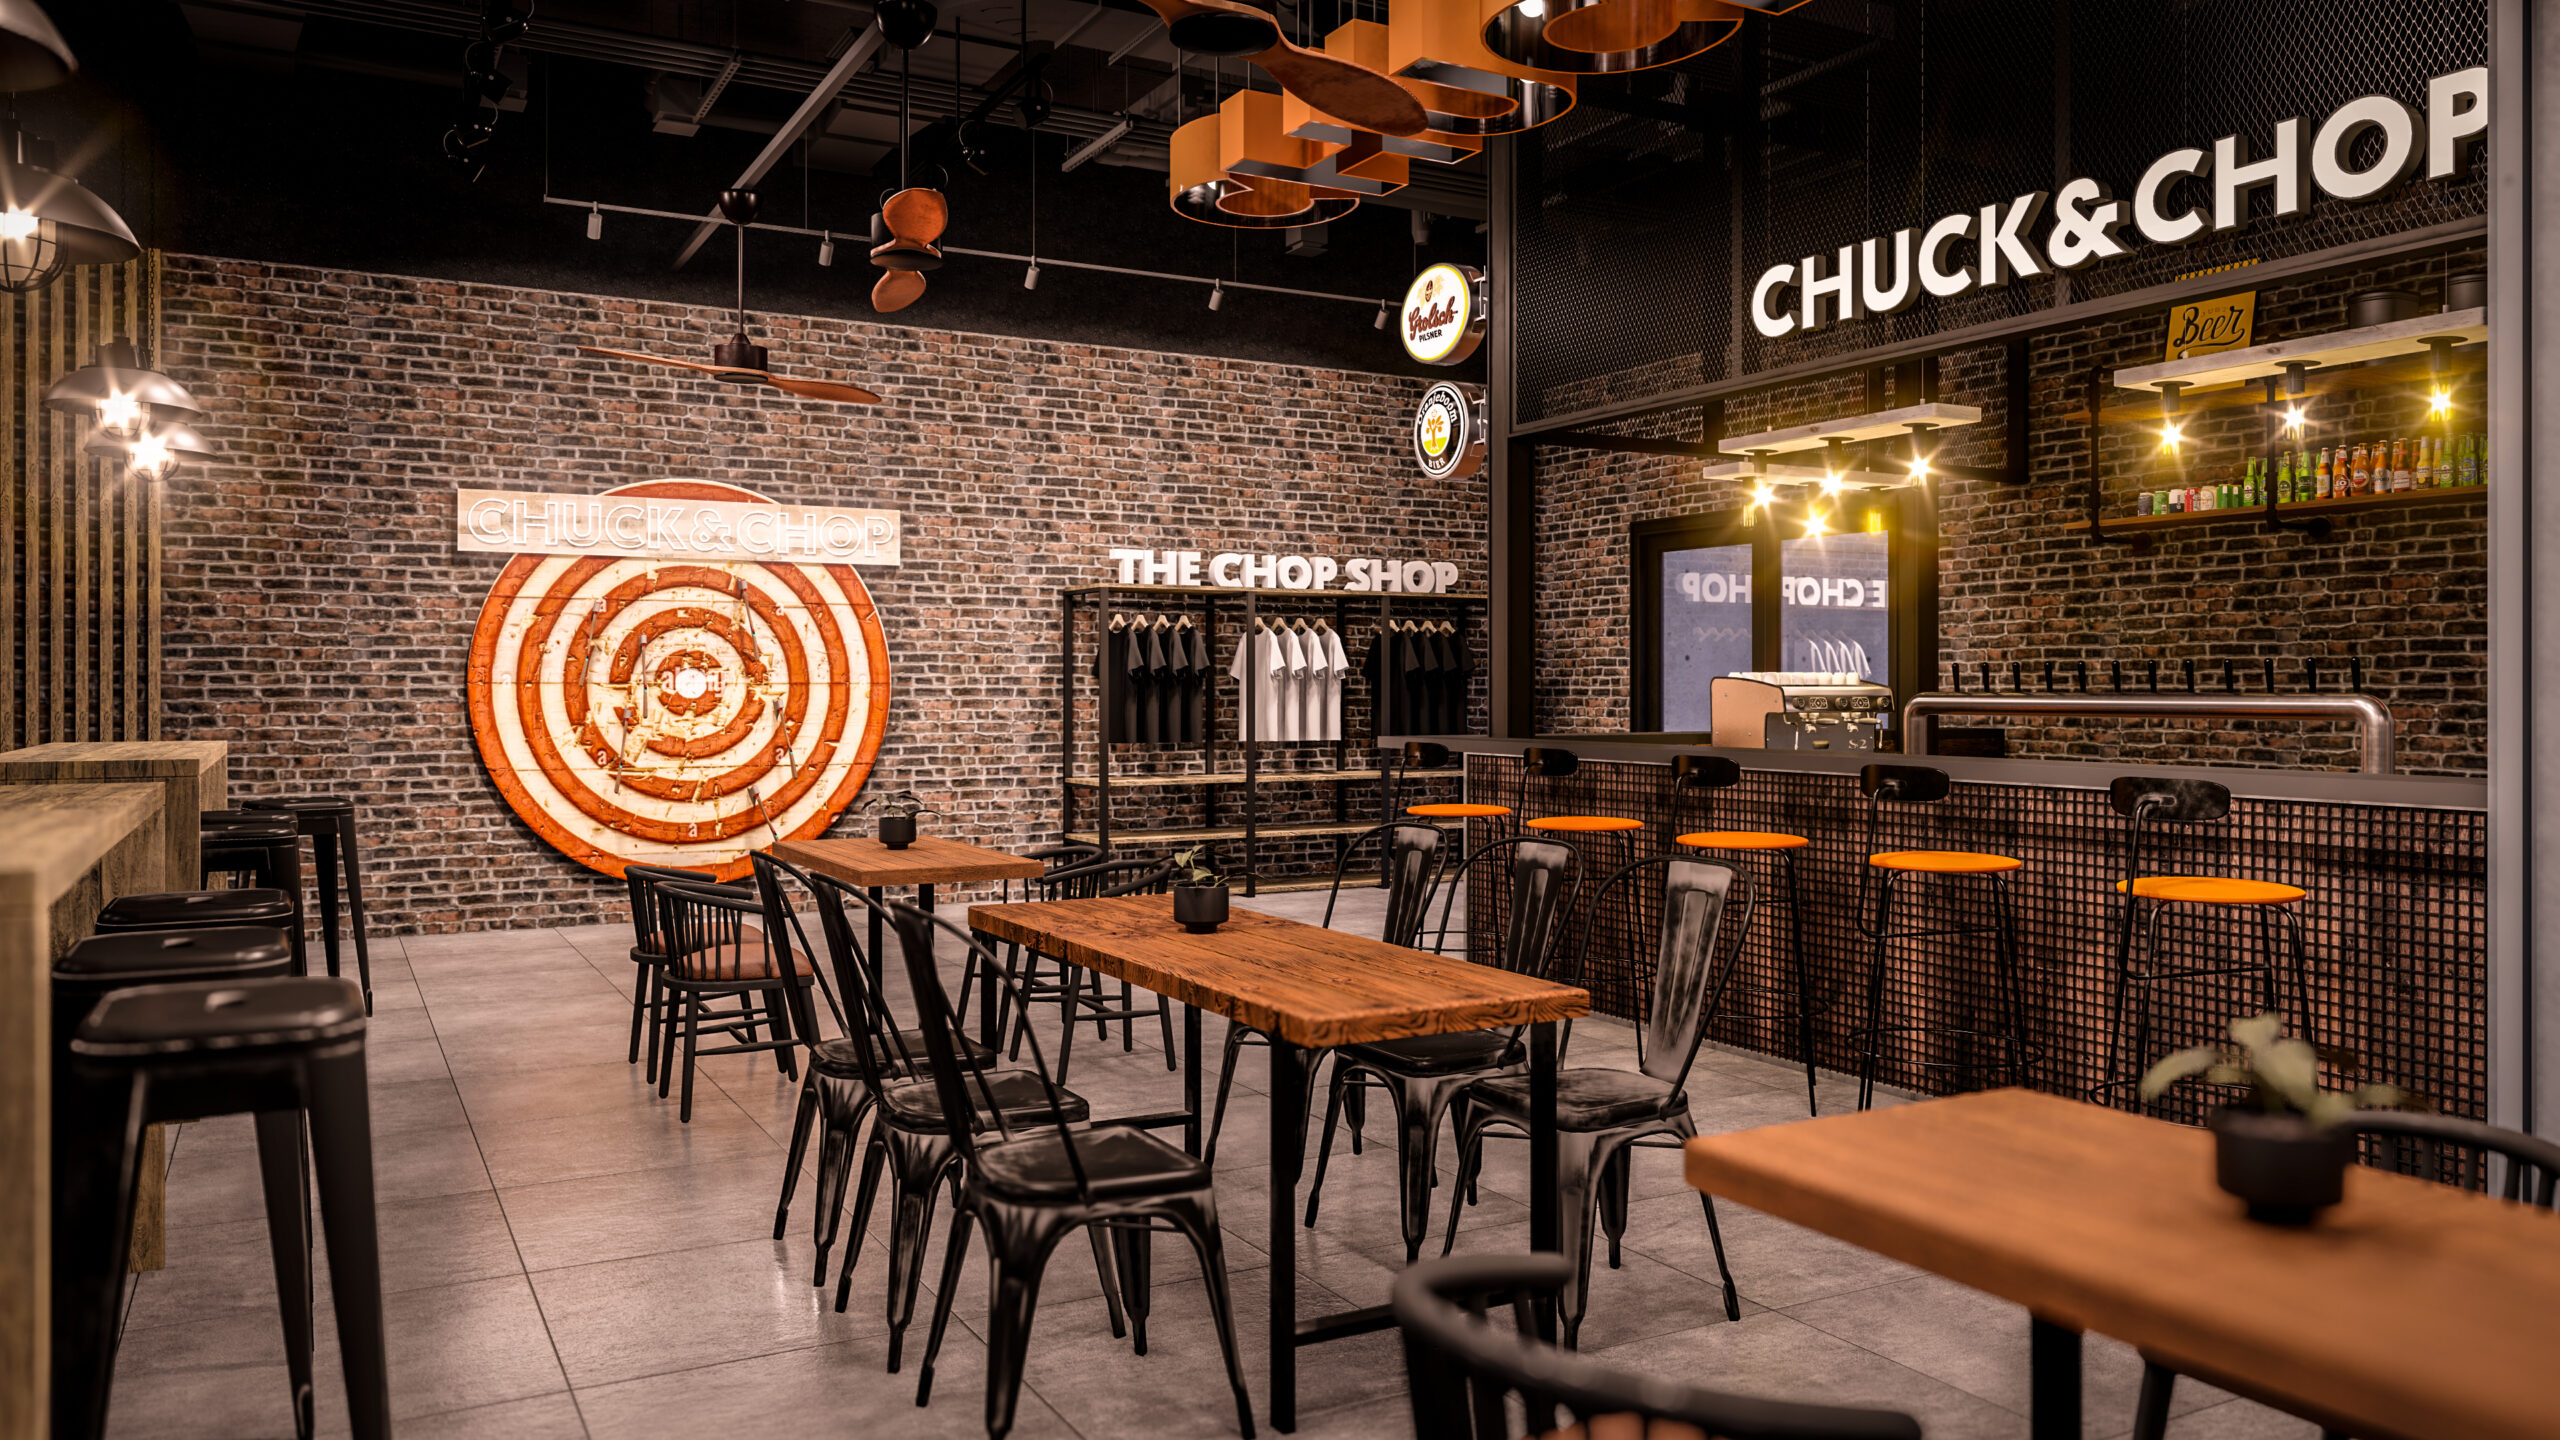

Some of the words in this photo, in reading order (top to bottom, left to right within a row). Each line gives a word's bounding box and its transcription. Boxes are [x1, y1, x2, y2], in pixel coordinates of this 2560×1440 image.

[1751, 66, 2488, 338] CHUCK&CHOP
[1408, 295, 1459, 341] Grolsch
[1418, 329, 1443, 342] PILSNER
[2173, 305, 2245, 348] Beer
[1428, 457, 1446, 469] BIER
[467, 497, 894, 557] CHUCK&CHOP
[1108, 548, 1202, 587] THE
[1208, 552, 1338, 590] CHOP
[1343, 557, 1459, 594] SHOP
